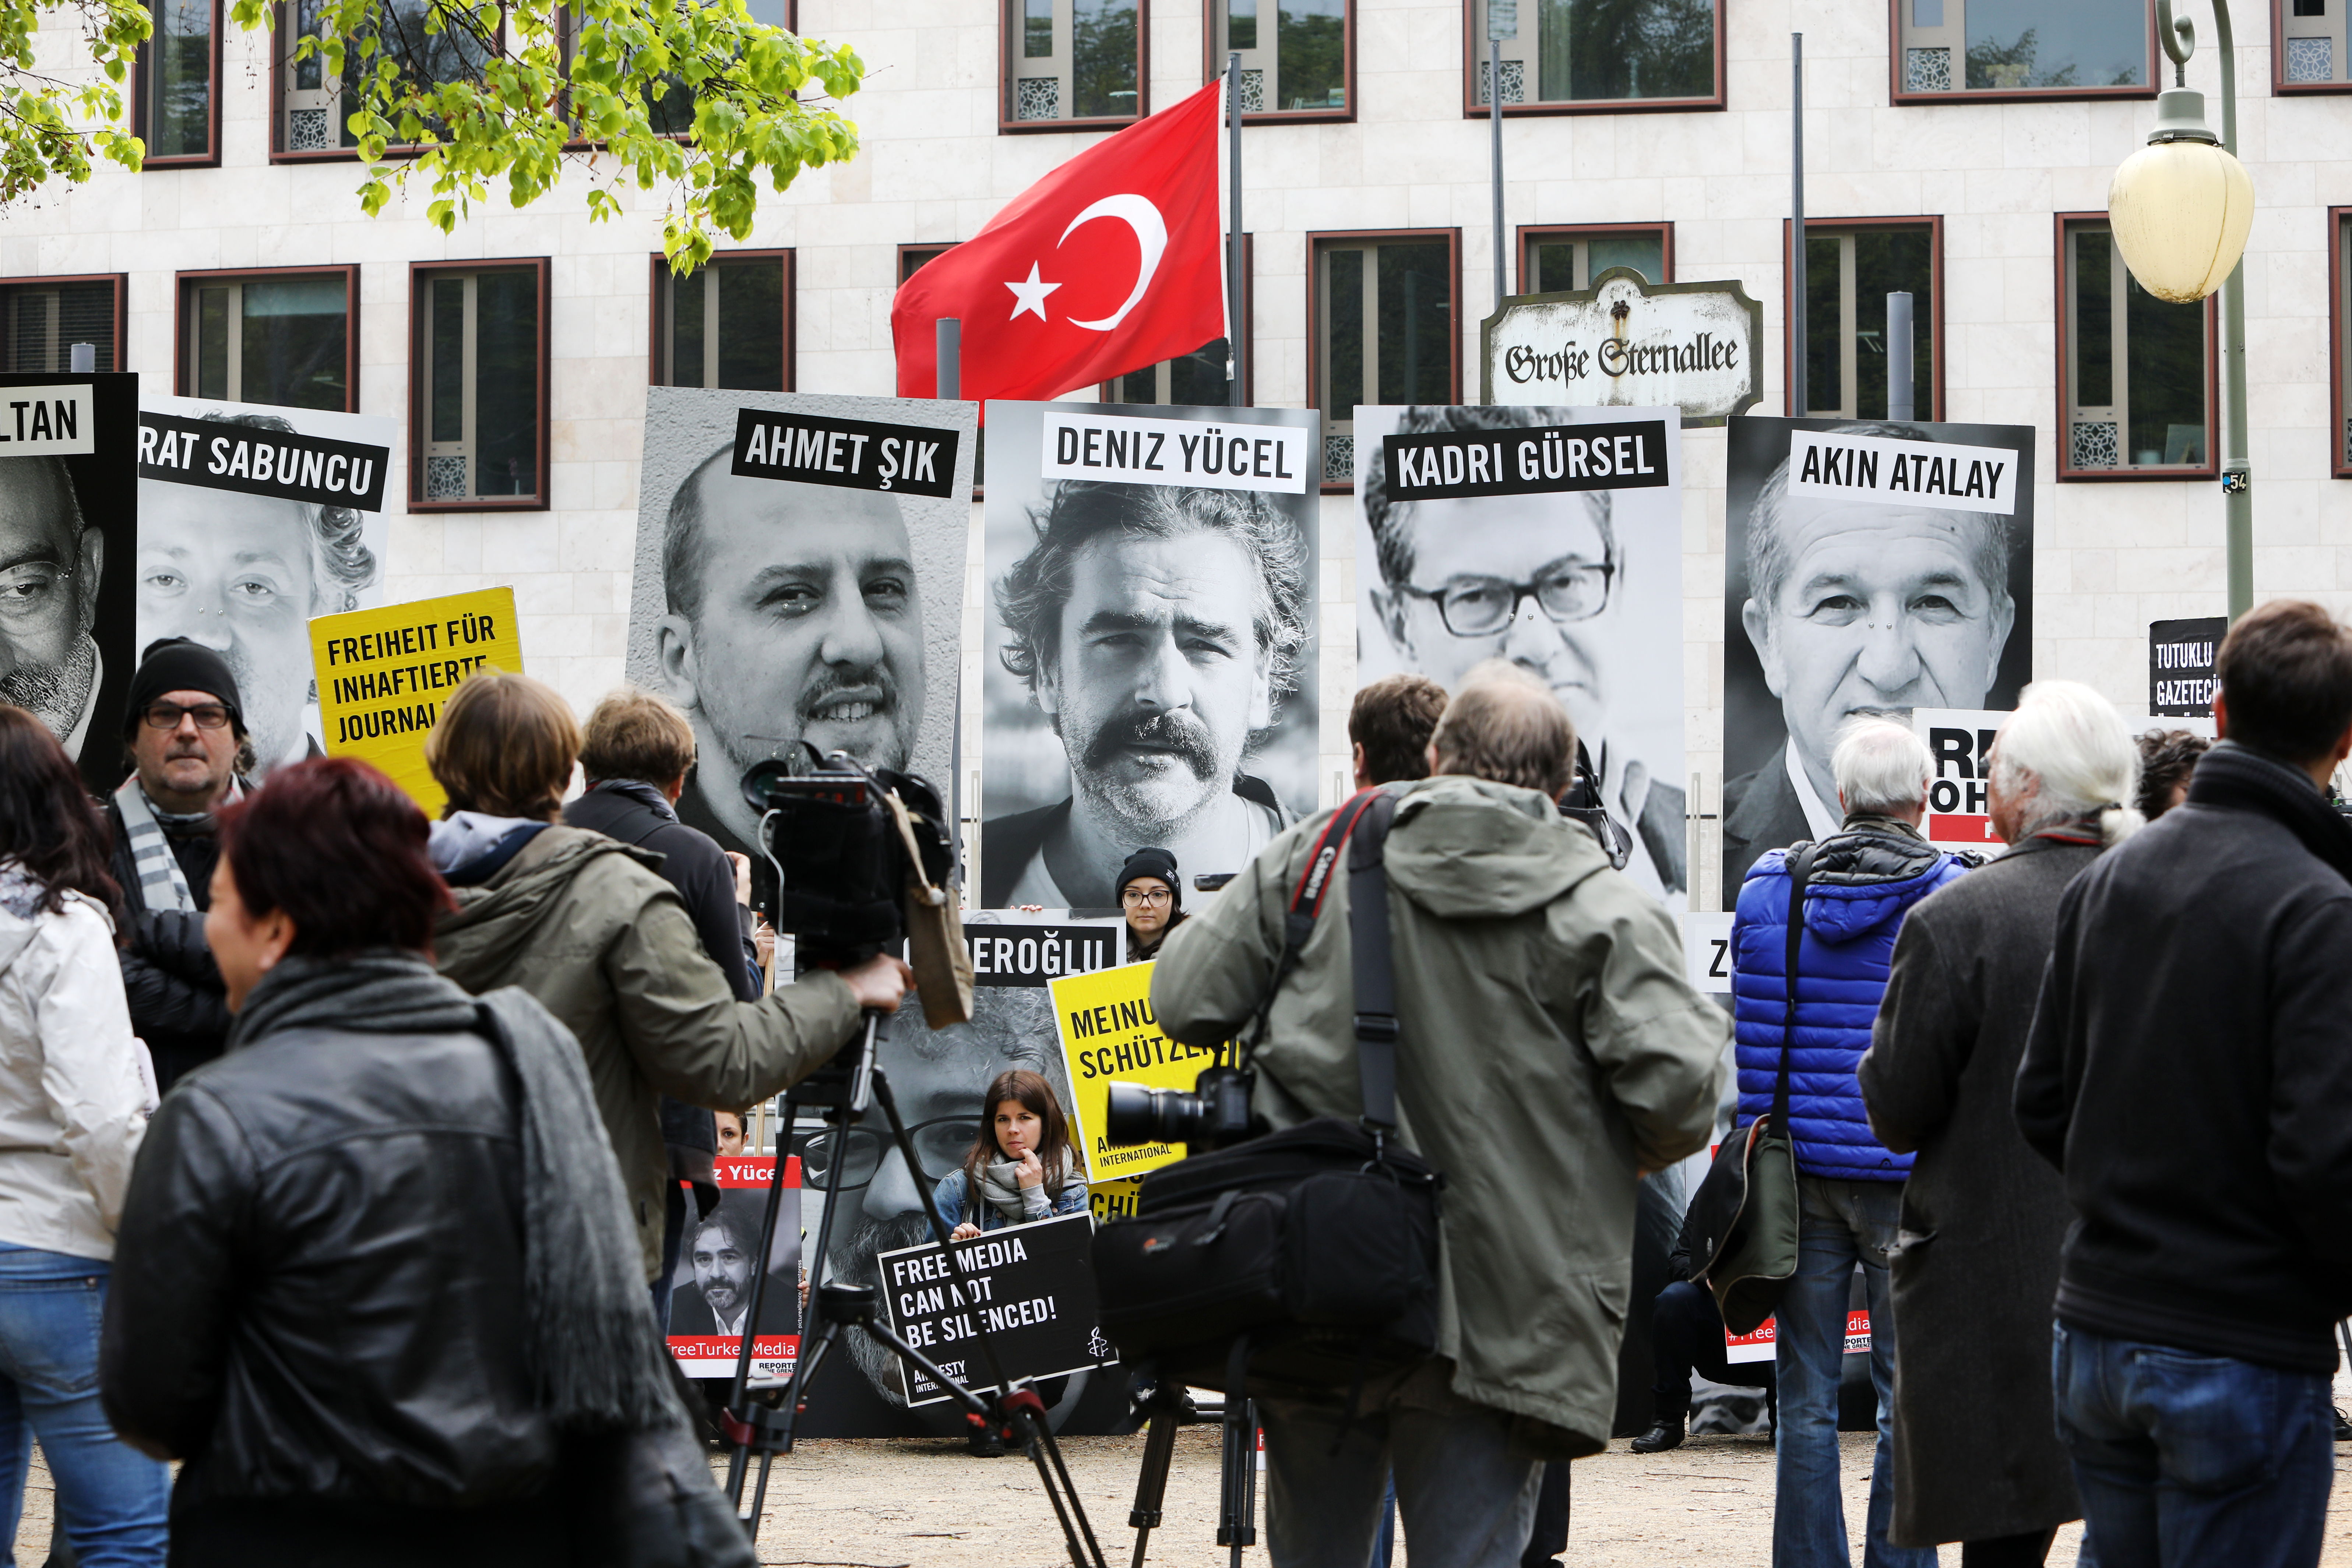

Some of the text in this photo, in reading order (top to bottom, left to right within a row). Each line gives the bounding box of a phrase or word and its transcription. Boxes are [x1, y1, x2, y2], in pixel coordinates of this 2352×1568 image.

[1505, 332, 1739, 389] Große Sternallee
[139, 426, 373, 495] RAT SABUNCU
[745, 424, 940, 490] AHMET ŞIK
[1057, 427, 1292, 479] DENIZ YÜCEL
[1398, 431, 1655, 488] KADRI GÜRSEL
[1800, 445, 2004, 499] AKIN ATALAY
[2230, 474, 2246, 490] 54
[327, 613, 496, 666] FREIHEIT FÜR
[2156, 642, 2212, 669] TUTUKLU
[339, 701, 447, 743] JOURNAL
[903, 930, 1103, 975] EROĞLU
[728, 1165, 784, 1180] Yüce
[1099, 1143, 1172, 1167] INTERNATIONAL
[893, 1238, 1028, 1286] FREE MEDIA
[899, 1276, 992, 1317] CAN NOT
[906, 1296, 1057, 1349] BE SILENCED!
